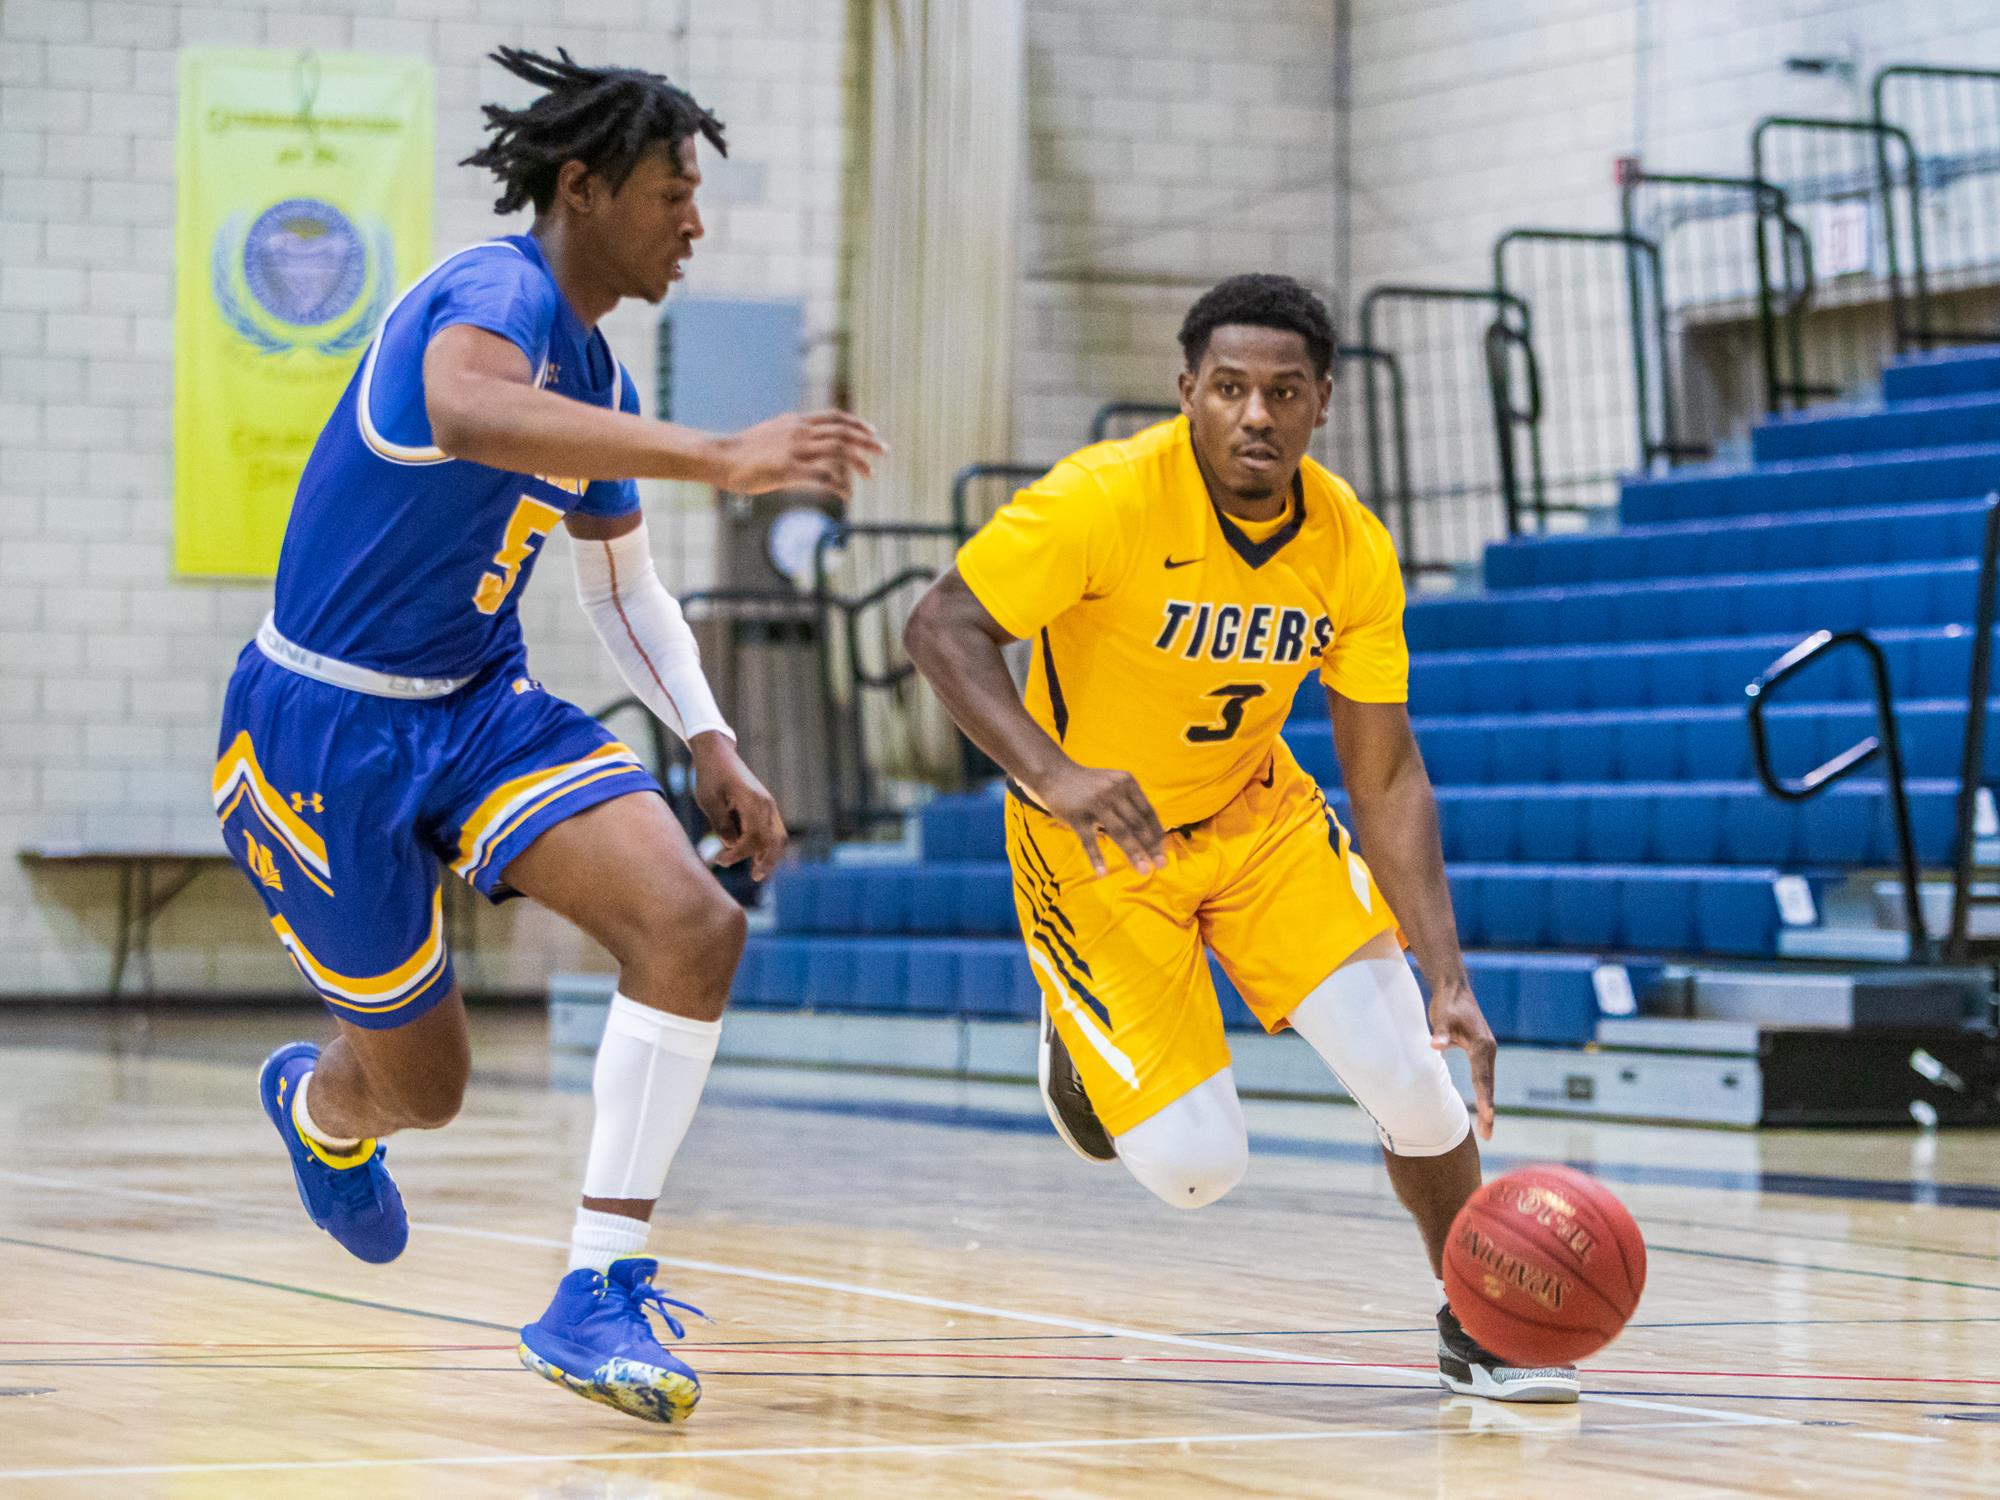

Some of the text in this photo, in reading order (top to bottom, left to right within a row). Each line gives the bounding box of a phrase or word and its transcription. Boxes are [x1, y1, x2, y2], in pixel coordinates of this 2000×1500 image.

[472, 494, 566, 615] 5
[1154, 599, 1336, 664] TIGERS
[1181, 680, 1271, 746] 3
